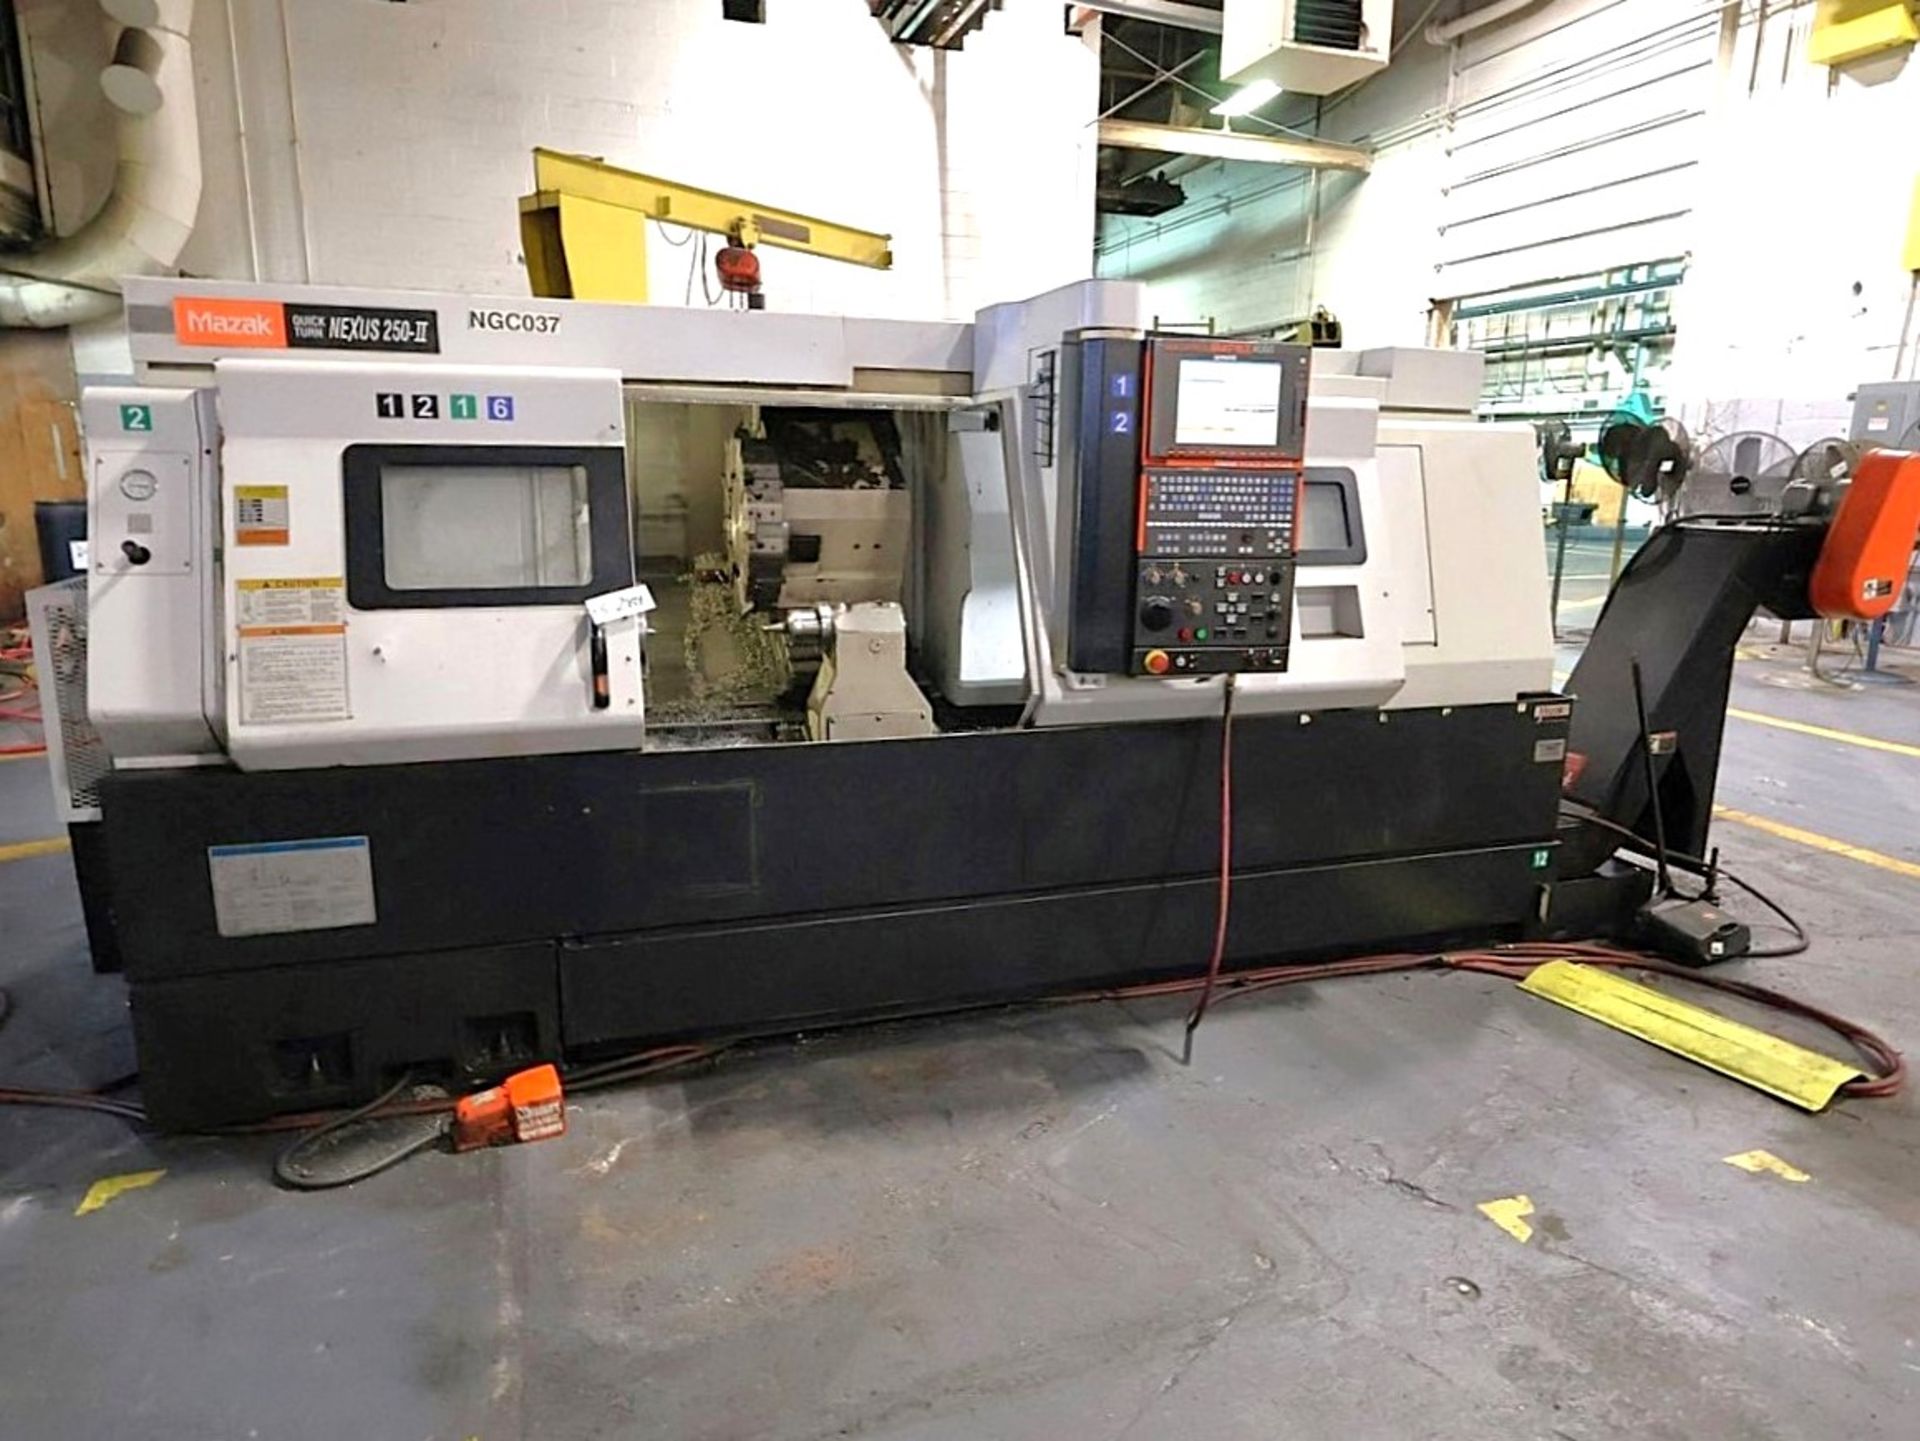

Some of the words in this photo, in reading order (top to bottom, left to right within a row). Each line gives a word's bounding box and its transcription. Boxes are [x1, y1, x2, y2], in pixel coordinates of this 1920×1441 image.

[186, 309, 273, 337] Mazak
[292, 315, 326, 327] QUICK
[328, 315, 380, 342] NEXUS
[469, 310, 560, 333] NGC037
[294, 327, 324, 339] TURN
[1116, 375, 1126, 396] 1
[383, 395, 396, 417] 1
[417, 396, 434, 418] 2
[456, 397, 469, 417] 1
[493, 398, 508, 419] 6
[127, 407, 145, 429] 2
[1114, 412, 1128, 432] 2
[1534, 850, 1549, 867] 12
